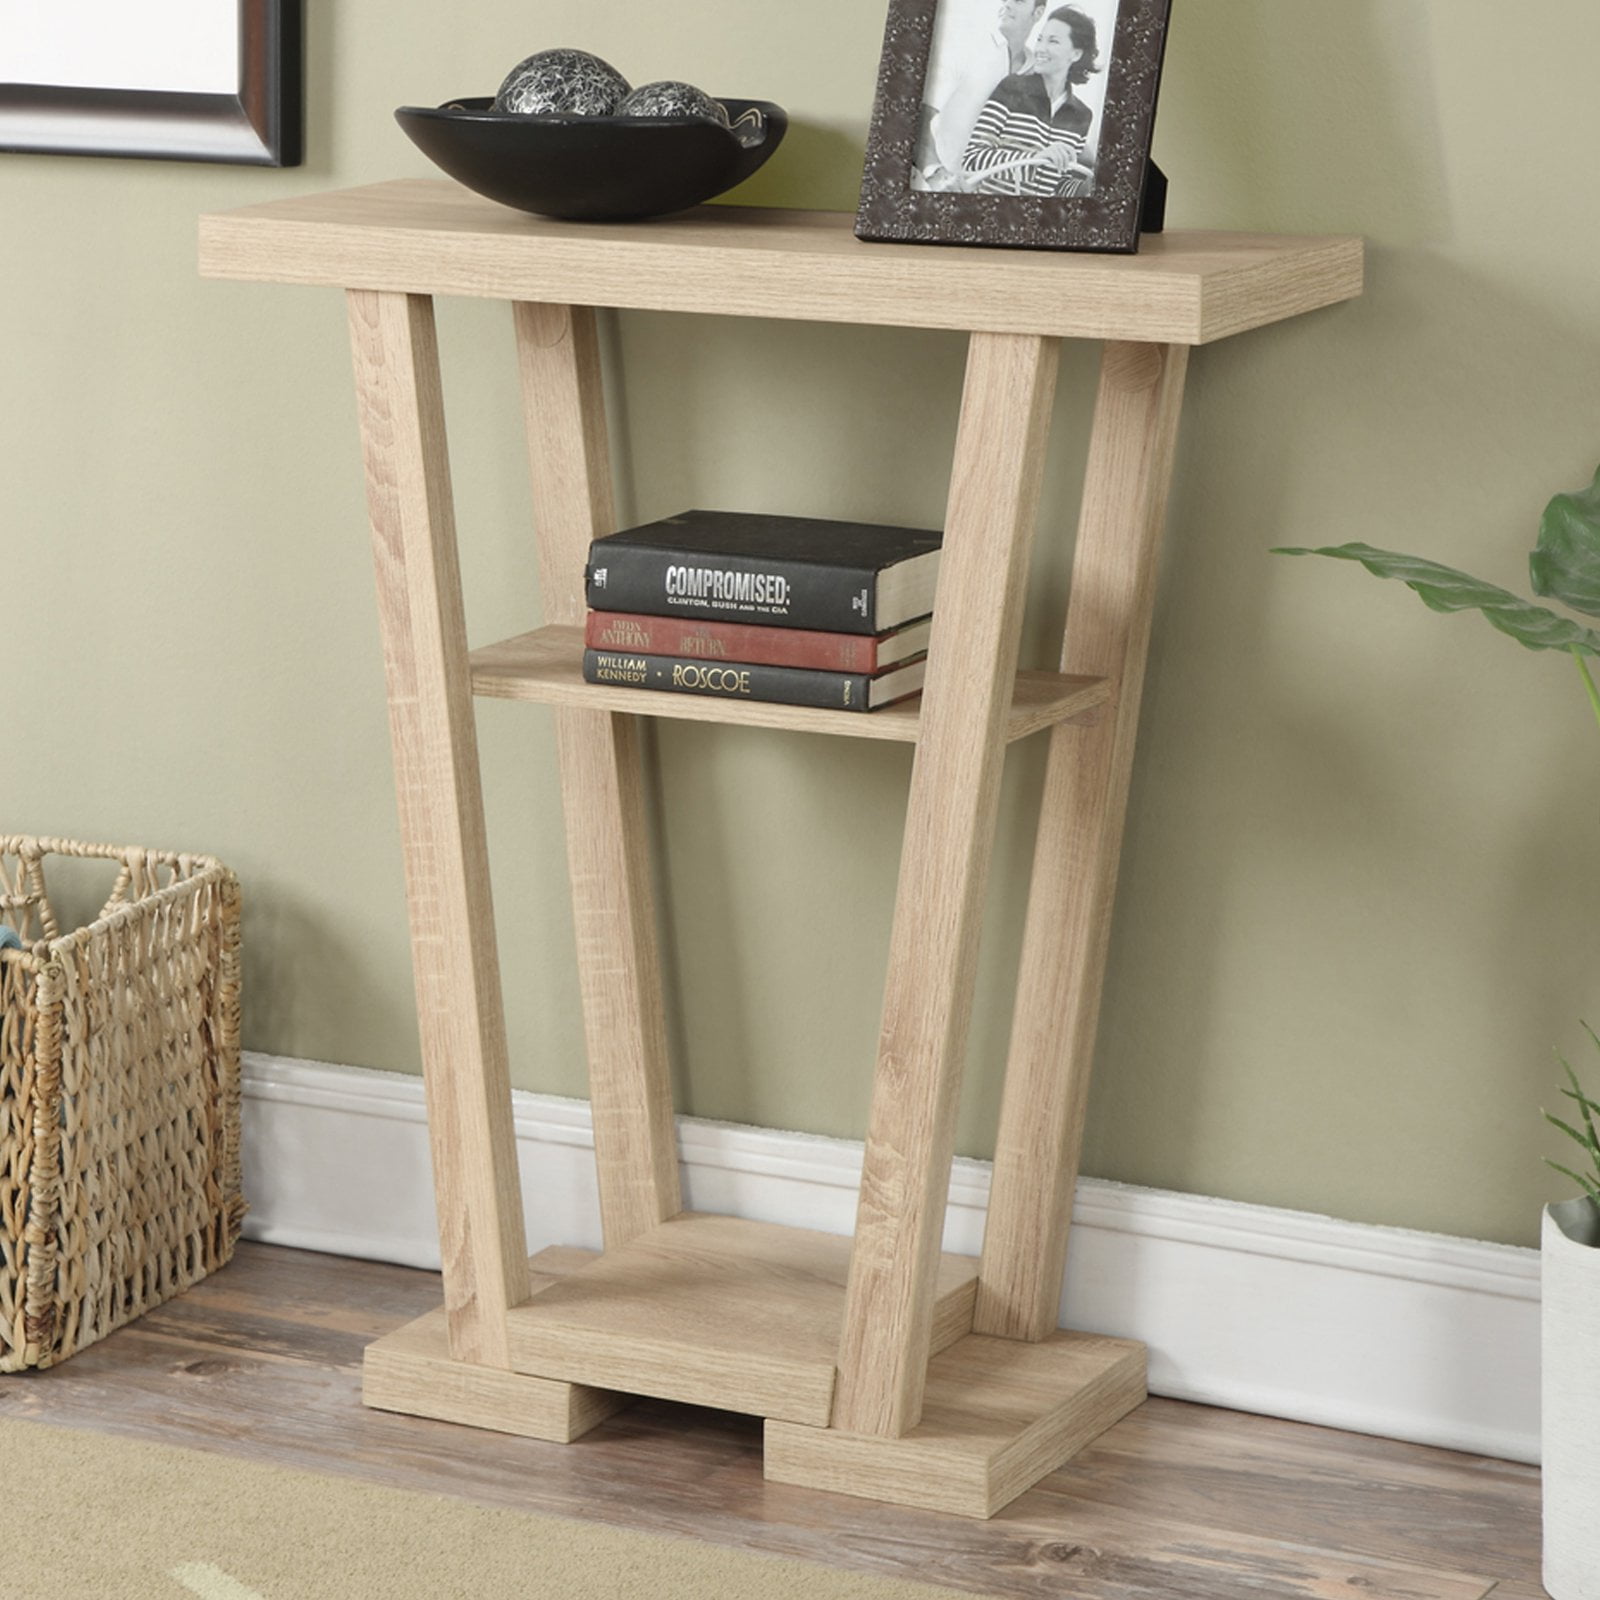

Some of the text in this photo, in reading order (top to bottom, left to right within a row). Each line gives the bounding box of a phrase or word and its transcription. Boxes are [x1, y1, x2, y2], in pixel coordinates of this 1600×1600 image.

[666, 565, 790, 605] COMPROMISED:
[667, 596, 710, 608] CLINTON,
[712, 601, 736, 609] BUSH
[771, 606, 788, 614] CIA
[600, 629, 651, 648] ANTHONY
[597, 656, 647, 671] WILLIAM
[597, 669, 647, 683] KENNEDY
[672, 664, 750, 693] ROSCOE
